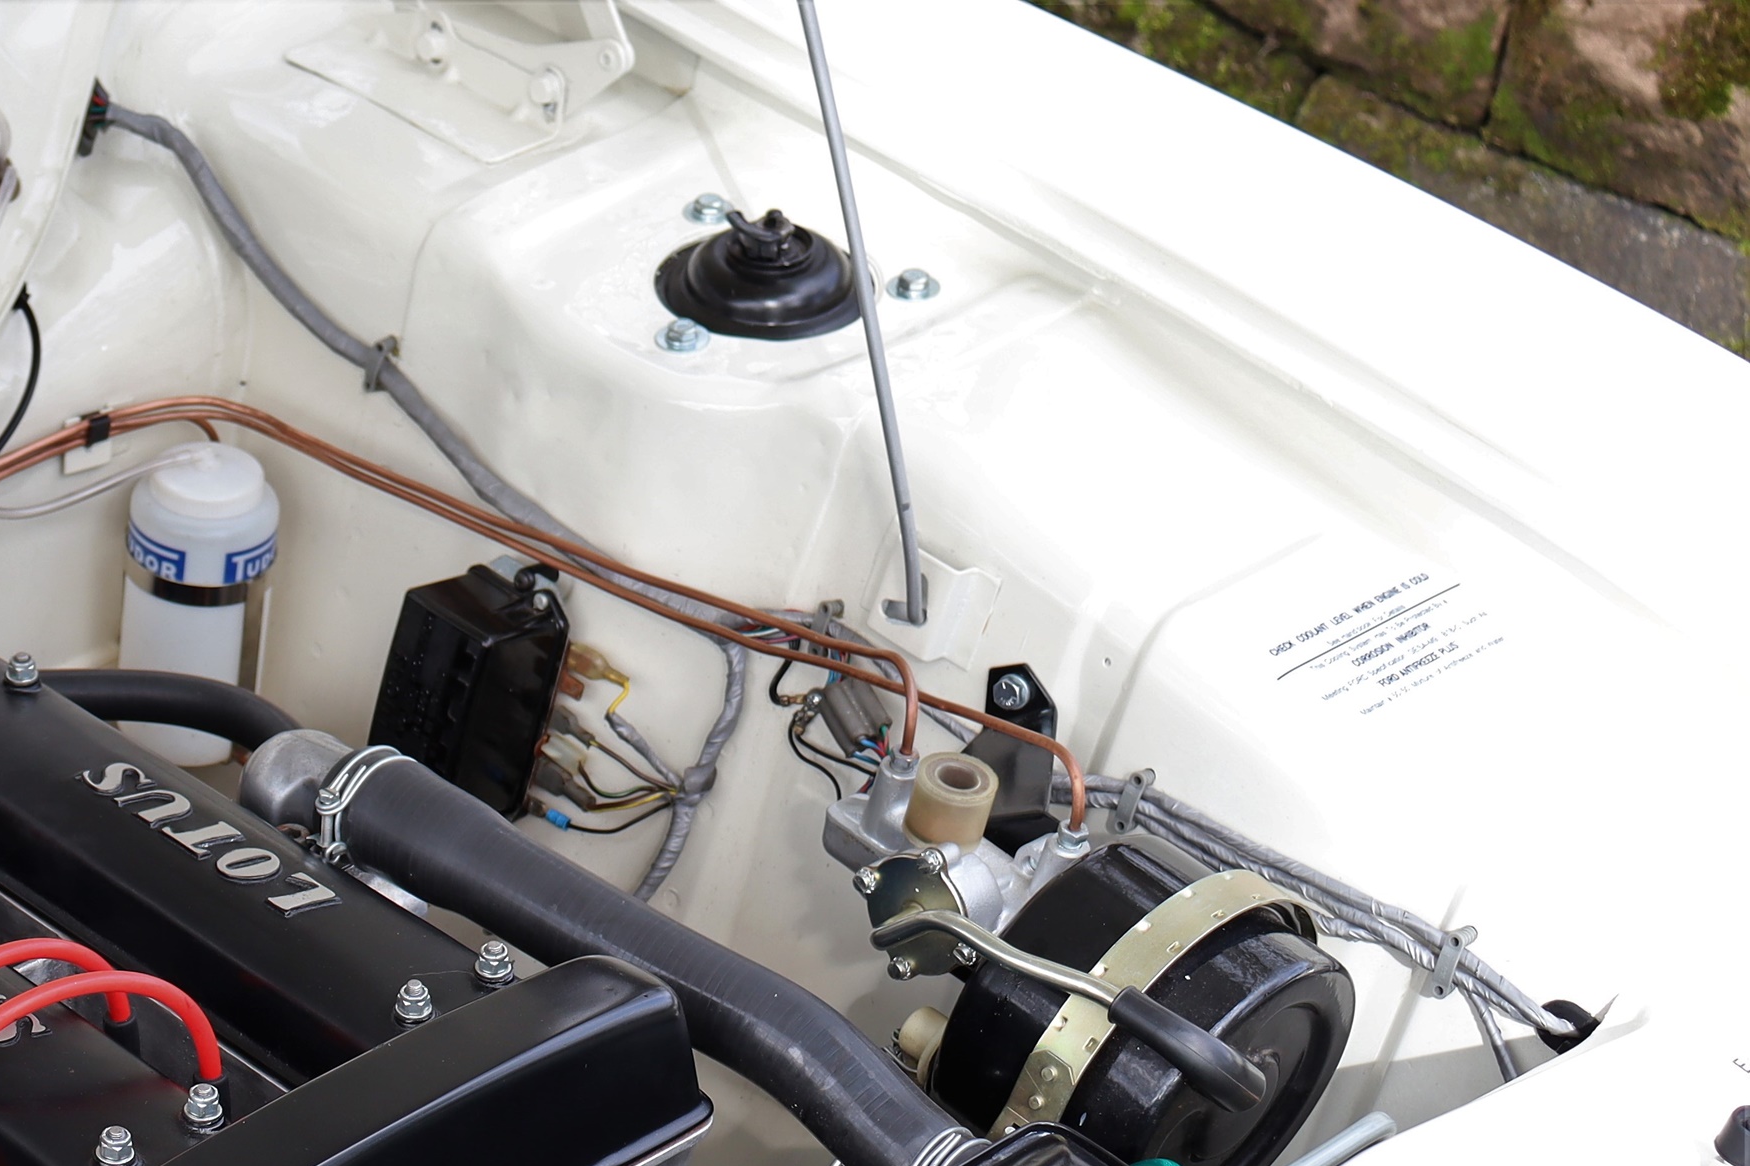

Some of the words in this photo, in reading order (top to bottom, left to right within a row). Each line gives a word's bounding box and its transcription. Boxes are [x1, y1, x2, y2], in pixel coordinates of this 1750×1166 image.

[1269, 640, 1294, 657] CHECK
[1295, 622, 1329, 644] COOLANT
[1329, 611, 1353, 627] LEVEL
[1352, 600, 1375, 616] WHEN
[1374, 587, 1401, 604] ENGINE
[1351, 642, 1394, 668] CORROSION
[1395, 623, 1430, 645] INHIBITOR
[1378, 673, 1400, 688] FORD
[78, 762, 342, 917] LOTUS
